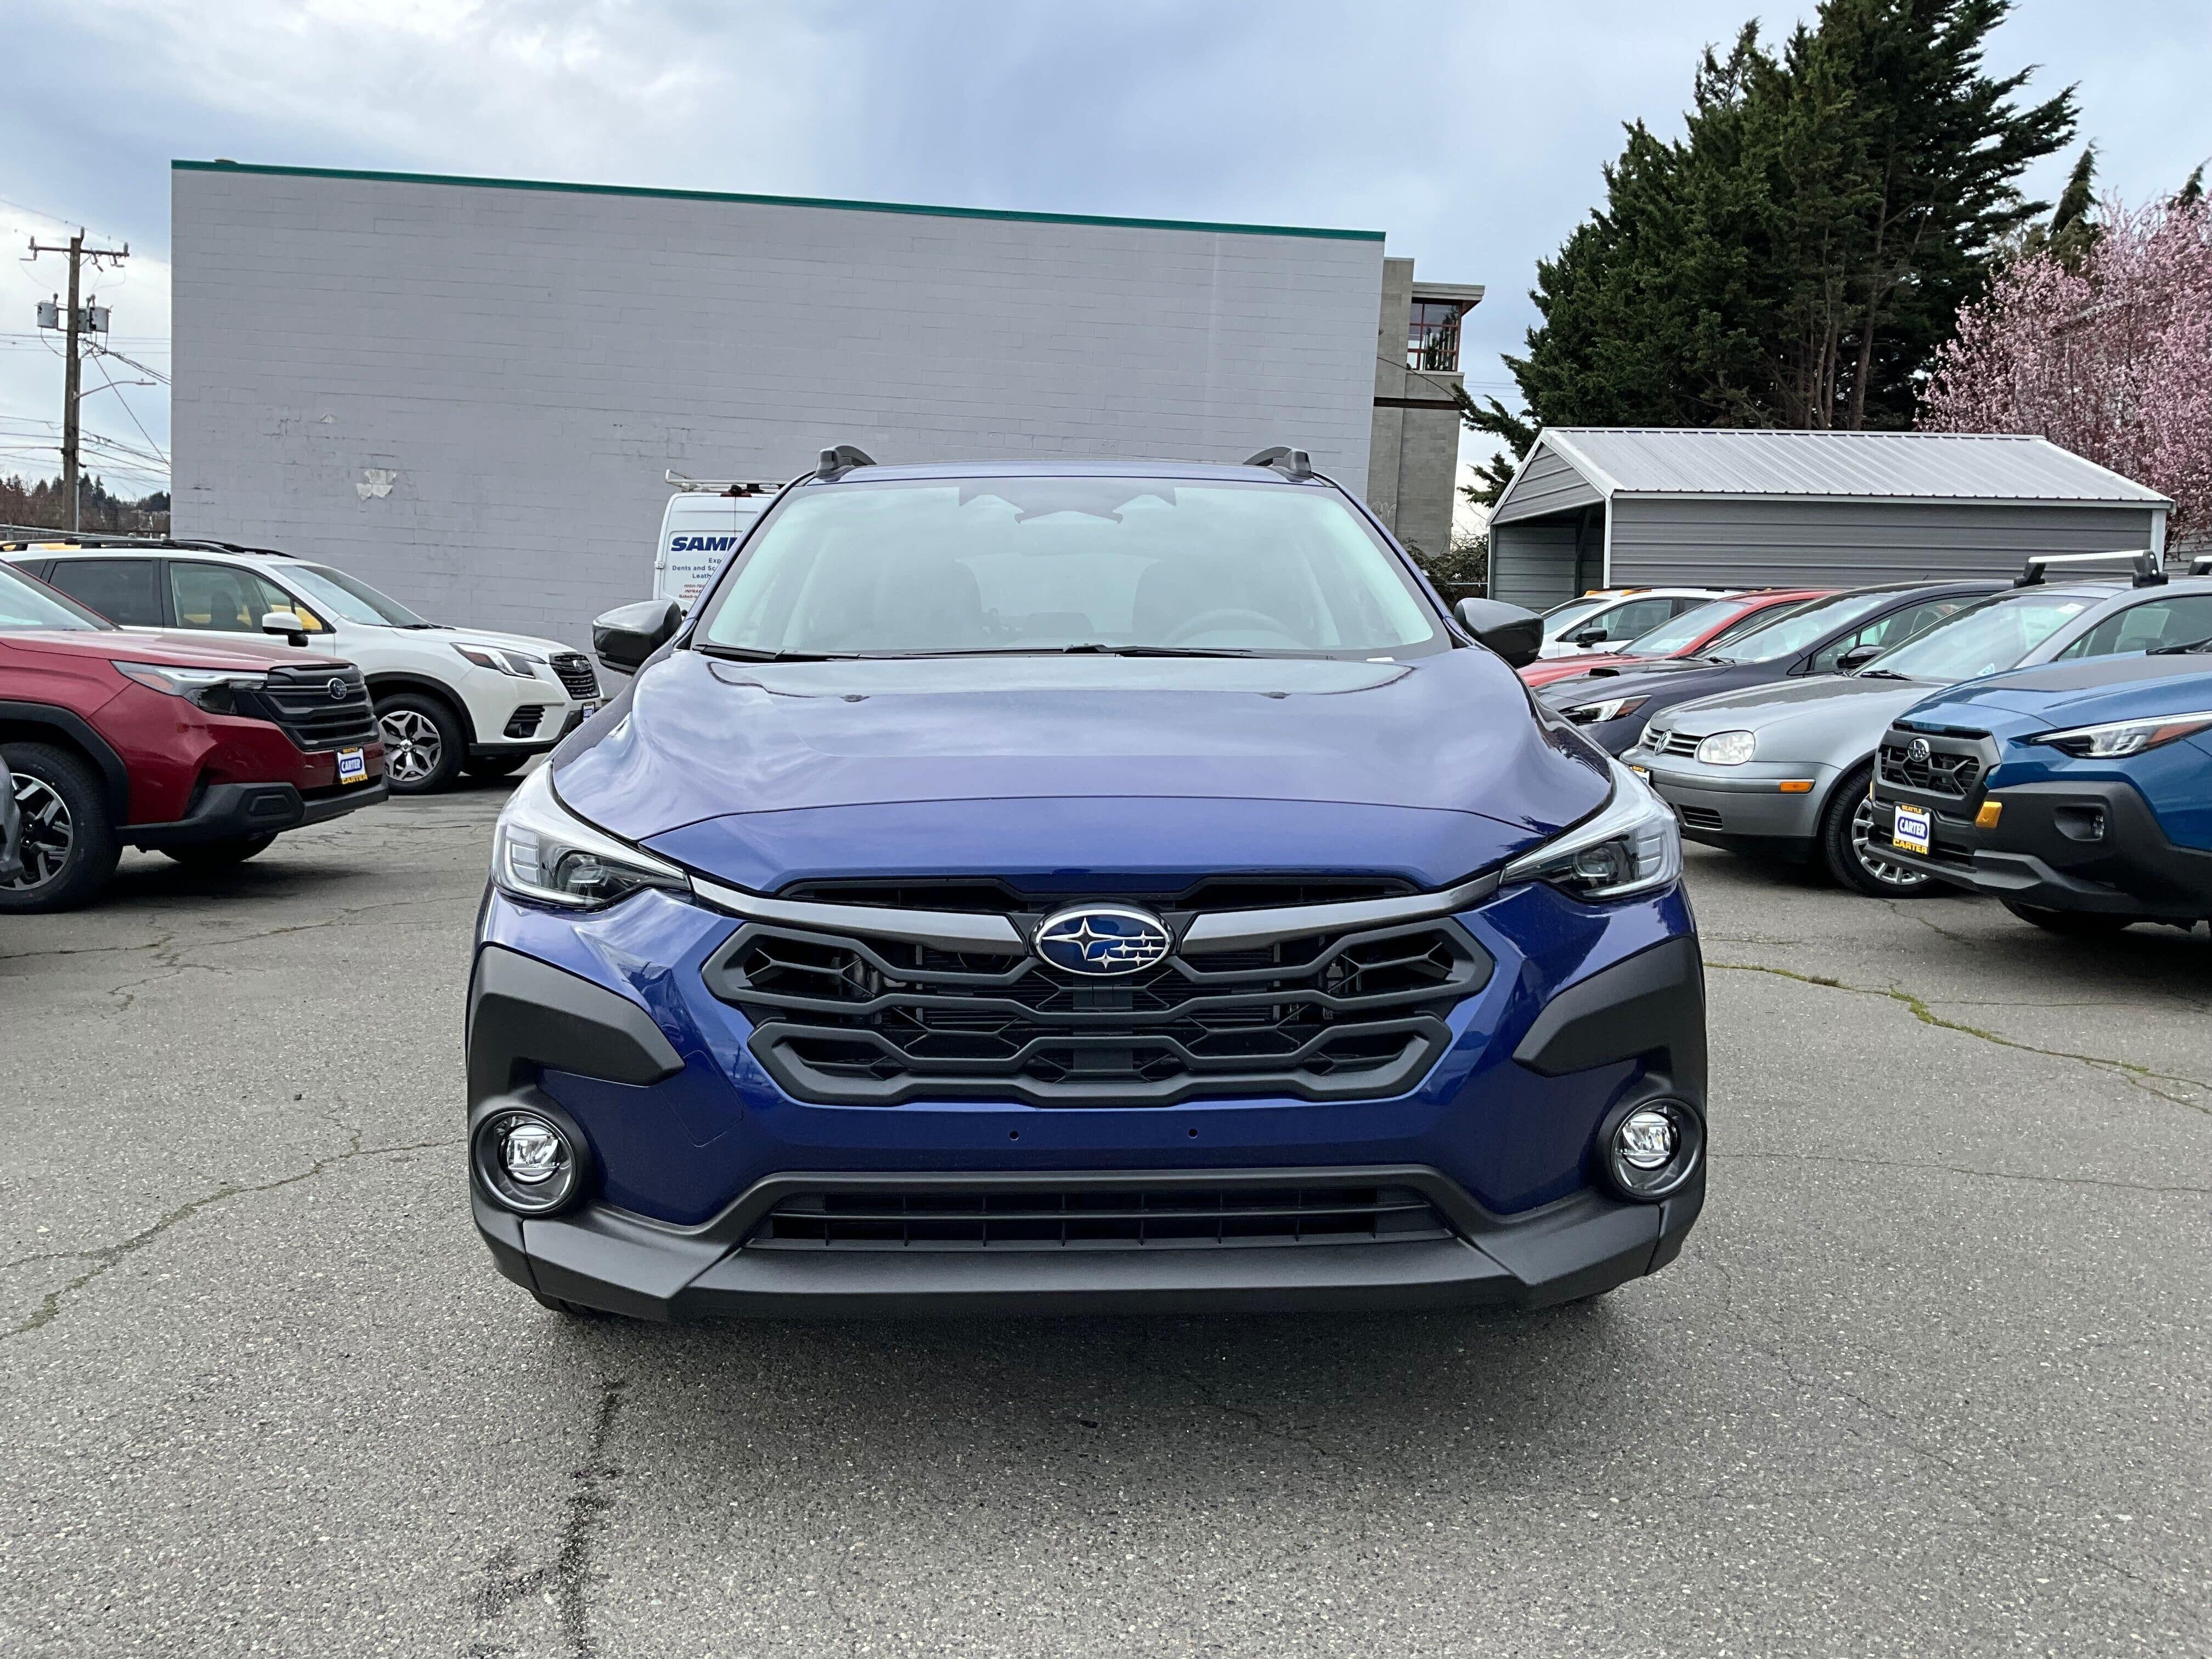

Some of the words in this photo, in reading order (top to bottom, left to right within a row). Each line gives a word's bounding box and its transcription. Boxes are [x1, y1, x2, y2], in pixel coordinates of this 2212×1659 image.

[341, 758, 361, 771] CARTER
[342, 774, 368, 785] CARTER
[1901, 805, 1922, 814] SEATTLE
[1899, 819, 1925, 837] CARTER
[1893, 838, 1927, 854] CARTER
